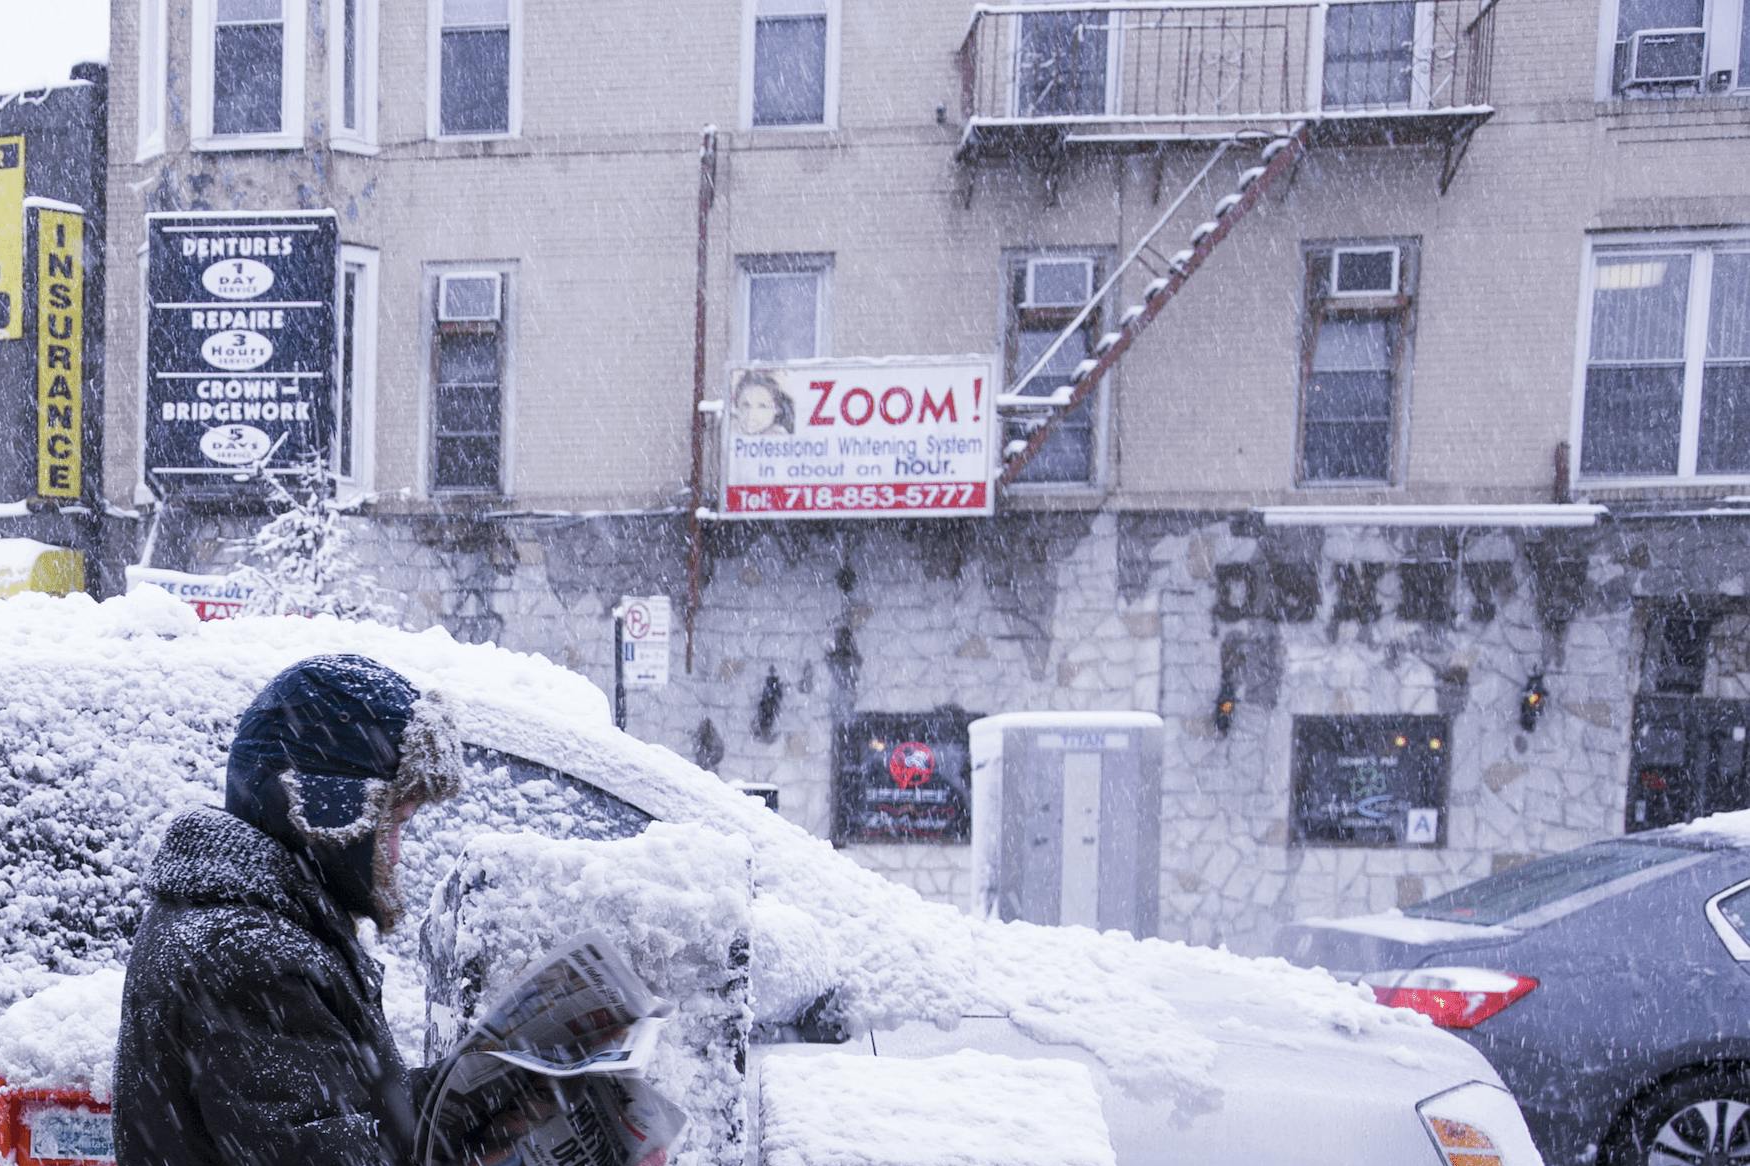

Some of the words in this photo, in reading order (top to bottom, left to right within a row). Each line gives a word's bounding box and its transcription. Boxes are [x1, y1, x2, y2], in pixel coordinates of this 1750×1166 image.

[181, 236, 294, 258] DENTURES
[218, 276, 256, 286] DAY
[190, 310, 286, 331] REPAIRE
[232, 333, 247, 347] 3
[45, 223, 76, 491] INSURANCE
[210, 345, 266, 357] Hours
[196, 380, 278, 401] CROWN
[162, 401, 312, 422] BRIDGEWORK
[229, 427, 244, 441] 5
[212, 442, 259, 451] DAYS
[734, 437, 829, 459] Professional
[838, 436, 917, 459] Whitening
[926, 434, 983, 457] System
[786, 462, 845, 479] about
[856, 464, 882, 477] an
[894, 456, 956, 478] hour.
[783, 483, 975, 510] 718-853-5777
[1413, 815, 1431, 834] A
